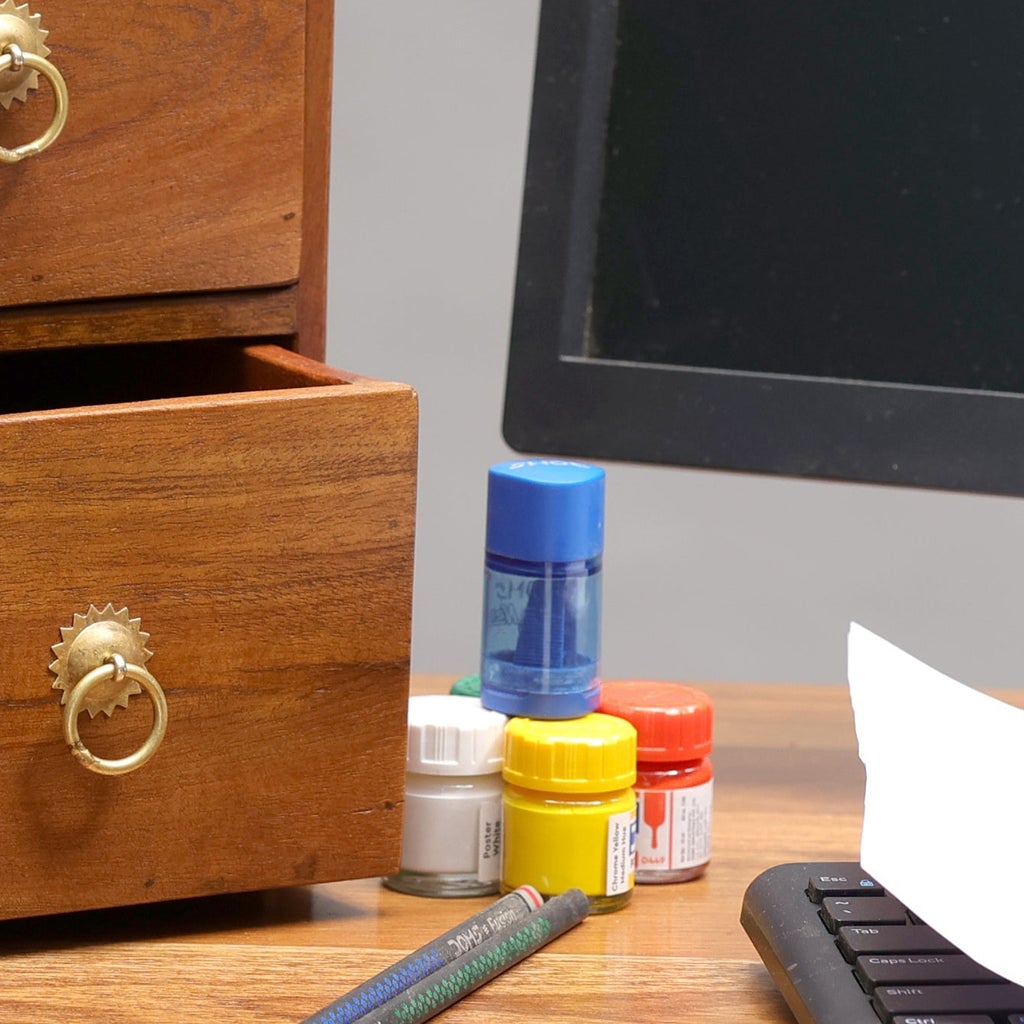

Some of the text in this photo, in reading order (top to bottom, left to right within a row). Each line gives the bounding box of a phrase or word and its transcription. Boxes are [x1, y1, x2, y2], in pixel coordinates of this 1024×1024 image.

[483, 822, 492, 858] Poster
[612, 823, 620, 853] Yellow
[886, 988, 923, 996] Shift
